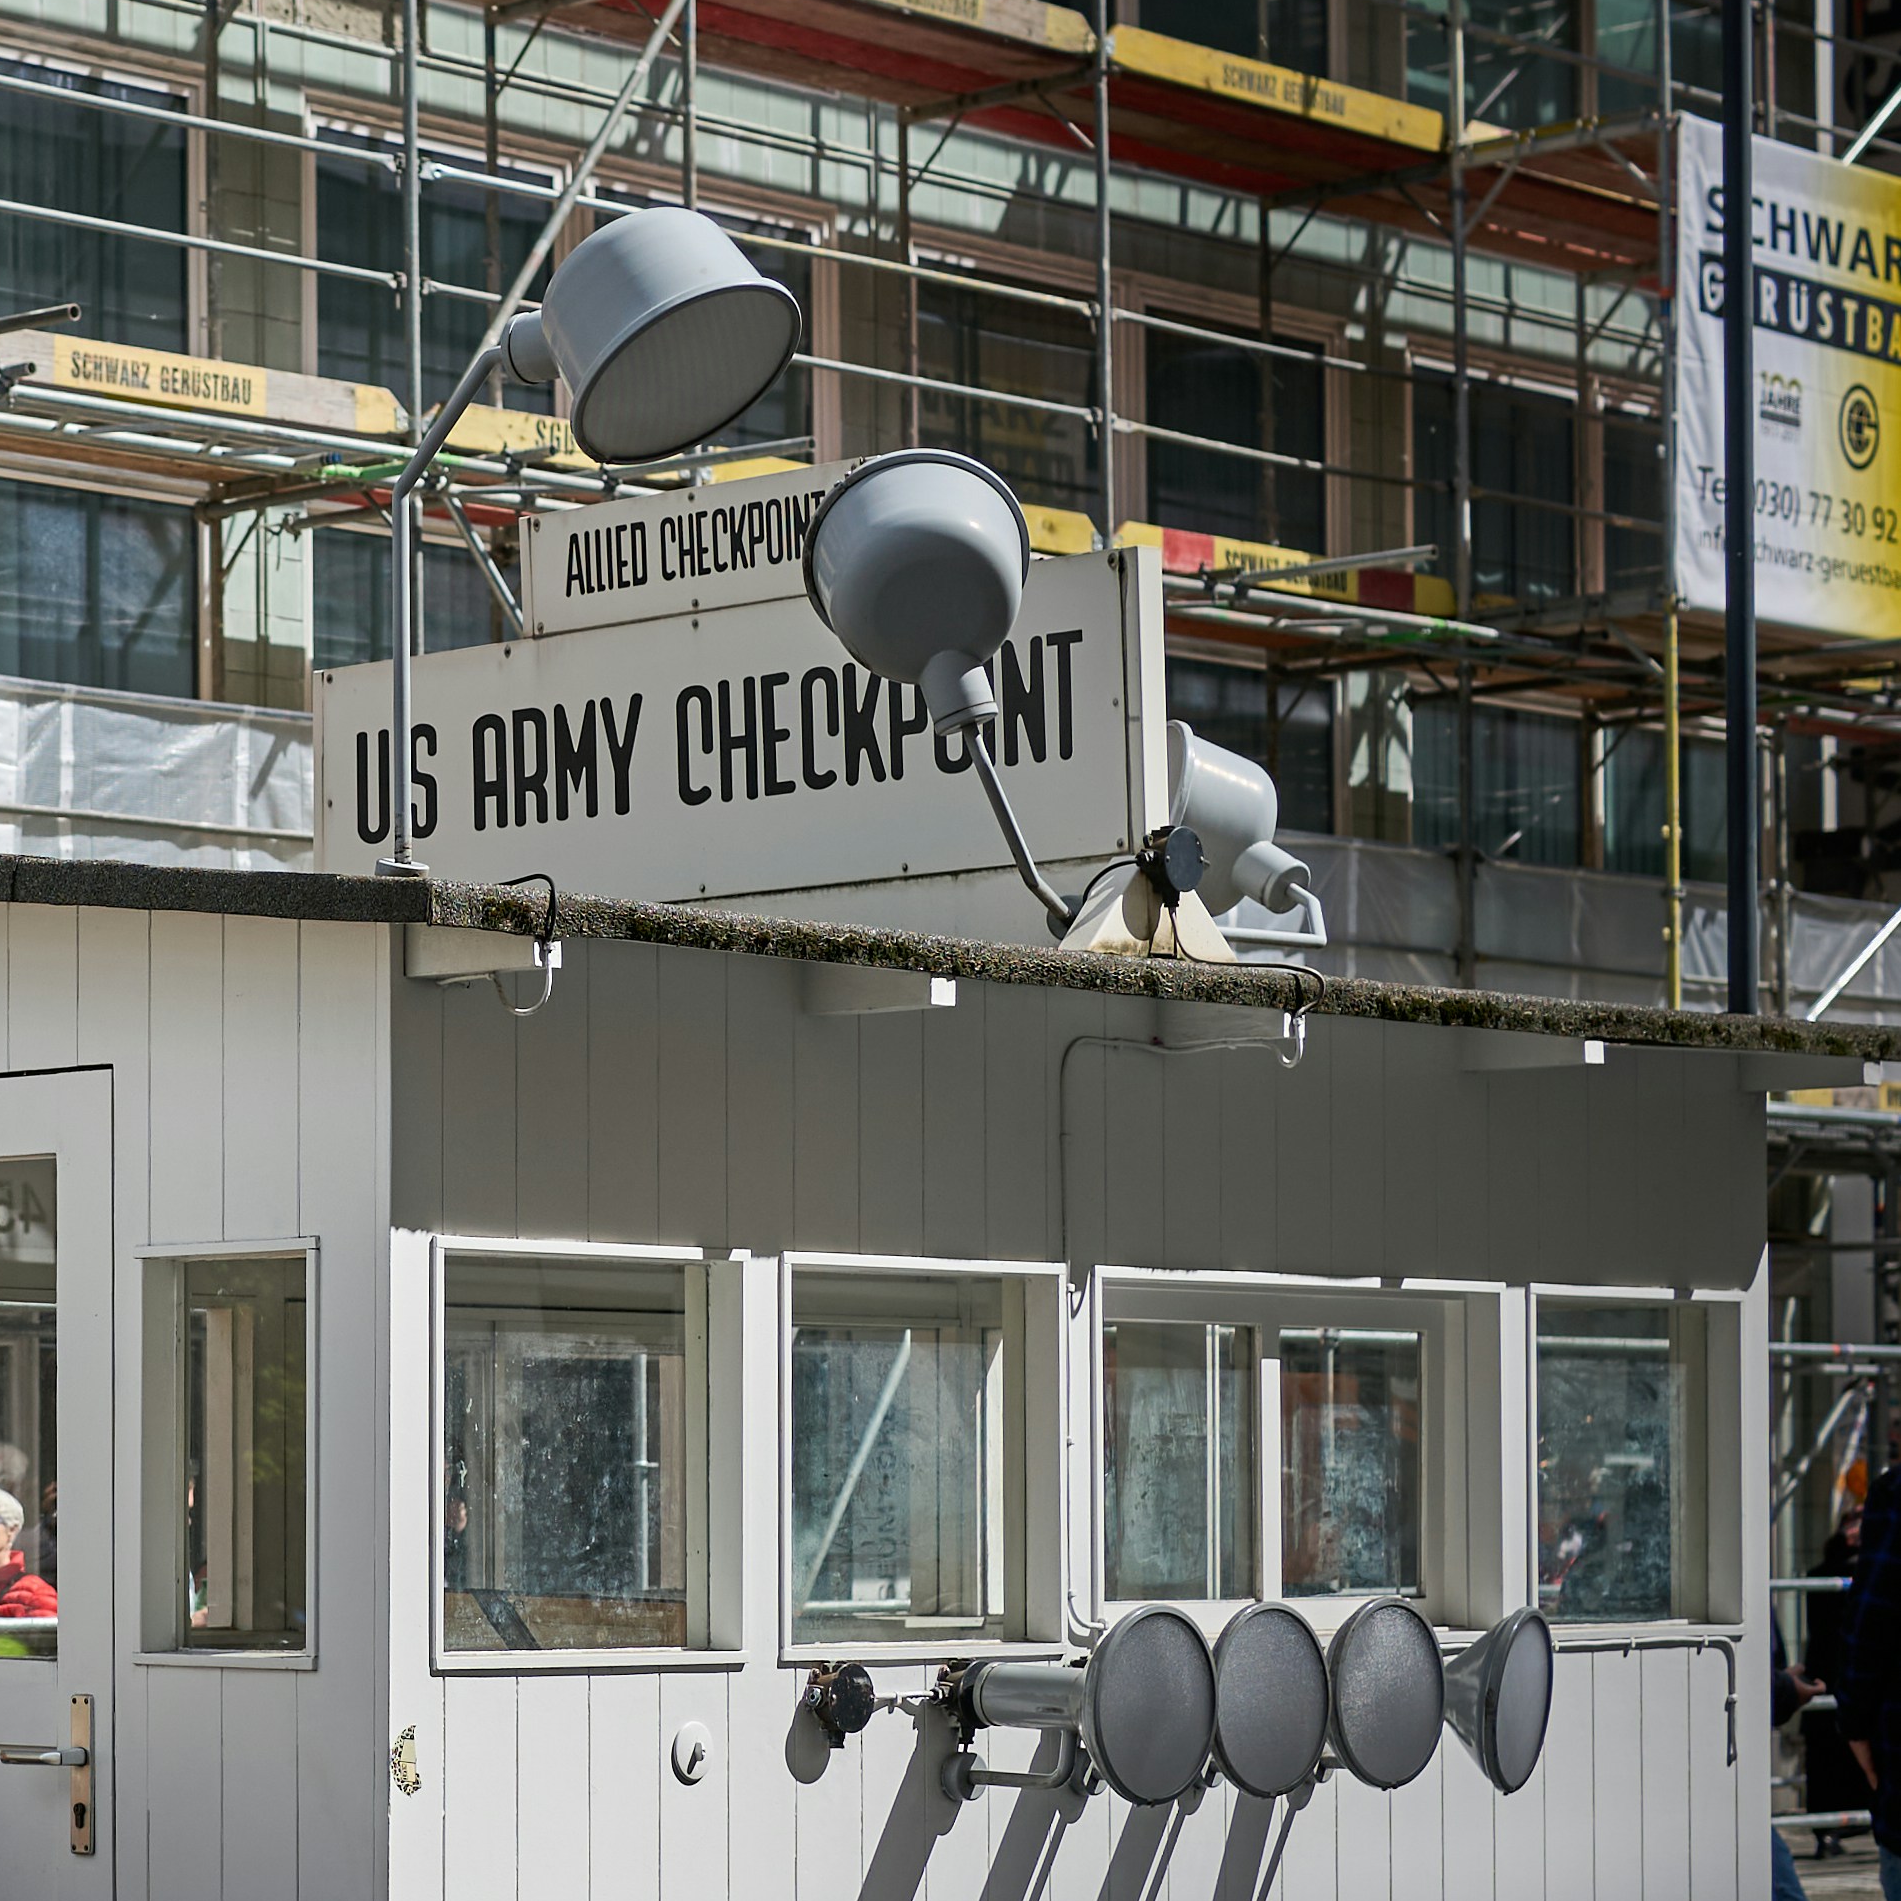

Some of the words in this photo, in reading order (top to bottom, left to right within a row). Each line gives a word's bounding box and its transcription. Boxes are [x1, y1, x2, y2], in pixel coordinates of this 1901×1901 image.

[1222, 63, 1277, 99] SCHWARZ
[1702, 261, 1901, 360] GRÜSTBA
[71, 349, 152, 390] SCHWARZ
[159, 366, 252, 407] GERÜSTBAU
[1697, 468, 1727, 504] Te
[1808, 489, 1835, 526] 77
[1839, 499, 1867, 539] 30
[1871, 506, 1898, 542] 92
[566, 523, 648, 598] ALLIED
[356, 722, 438, 844] US
[473, 693, 643, 832] ARMY
